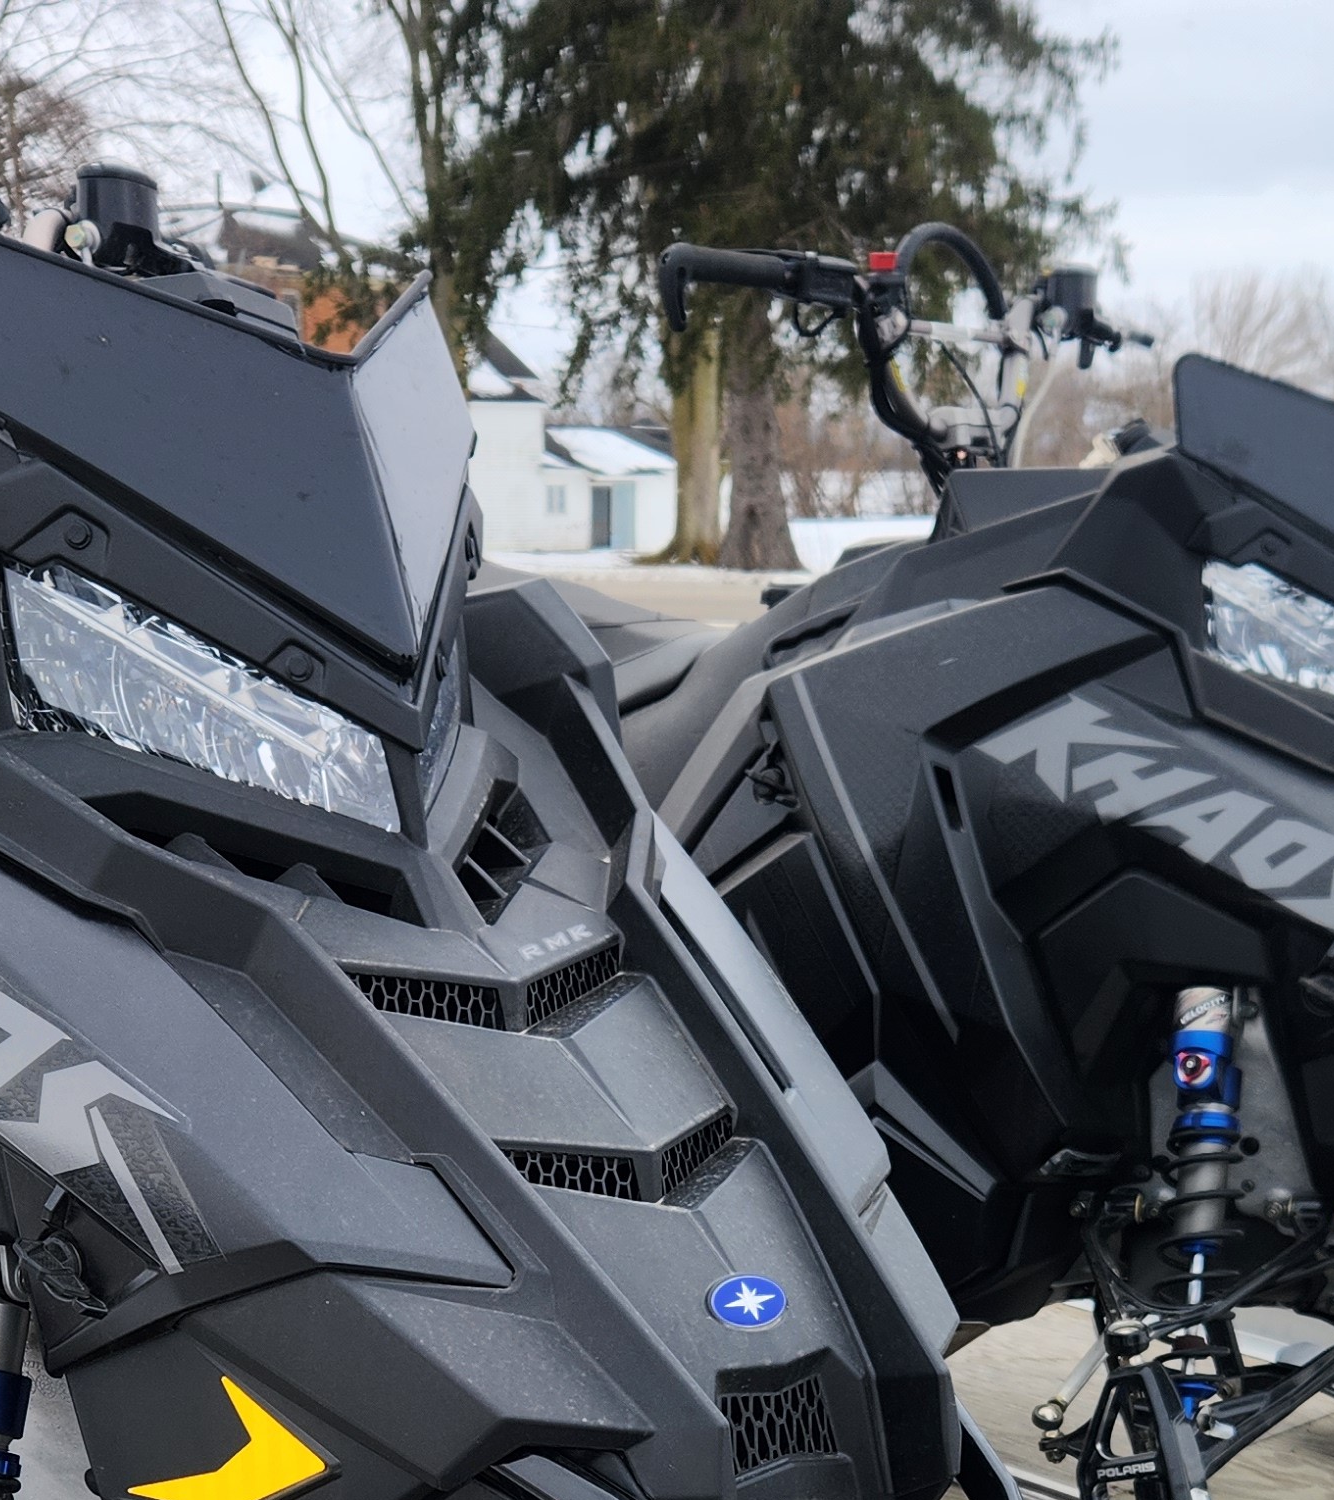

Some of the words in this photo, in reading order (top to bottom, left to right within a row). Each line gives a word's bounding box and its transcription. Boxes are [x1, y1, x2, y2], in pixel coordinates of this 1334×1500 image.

[518, 923, 593, 962] RMK
[1179, 994, 1227, 1026] VELOCITY
[1097, 1461, 1156, 1479] POLARIS
